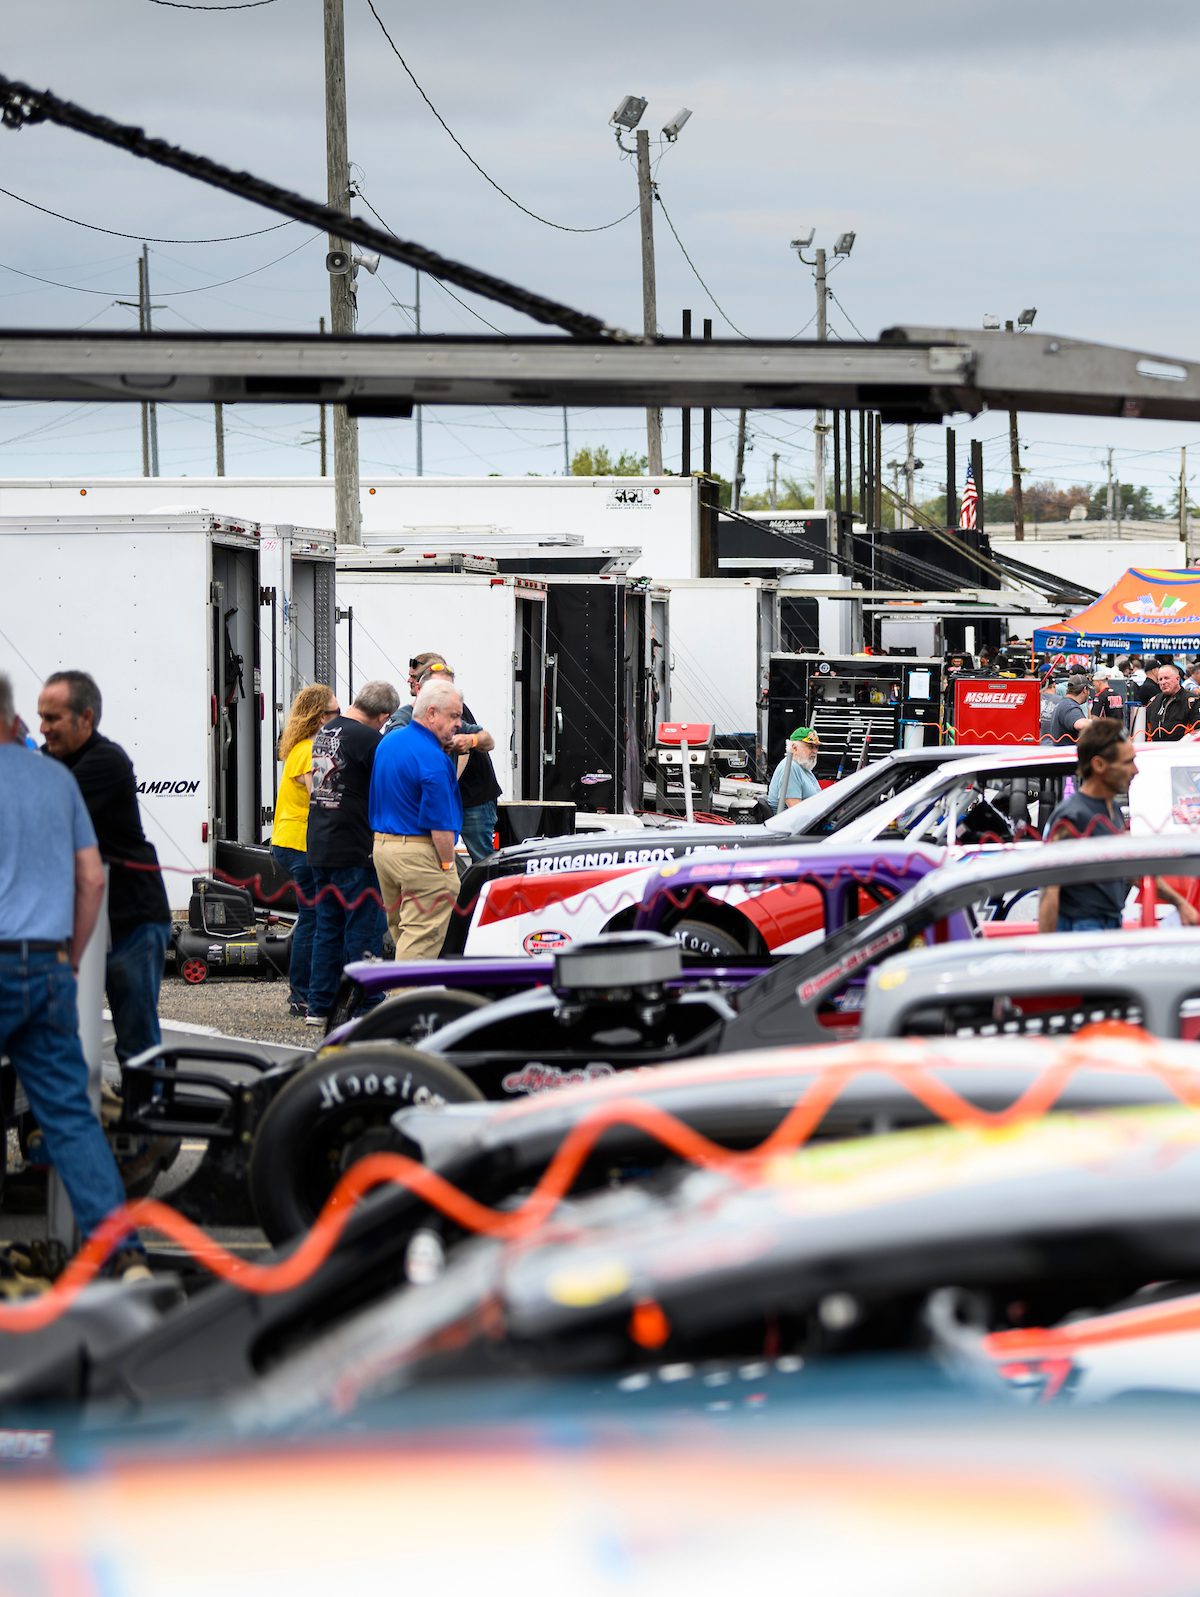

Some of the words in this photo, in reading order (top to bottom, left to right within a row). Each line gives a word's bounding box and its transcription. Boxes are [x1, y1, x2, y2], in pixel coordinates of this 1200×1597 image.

[1112, 615, 1200, 625] Motorsports
[1045, 636, 1067, 649] 64
[1076, 638, 1101, 648] Screen
[1101, 638, 1130, 650] Printing
[136, 781, 200, 794] AMPION
[526, 852, 618, 874] BRIGANDI
